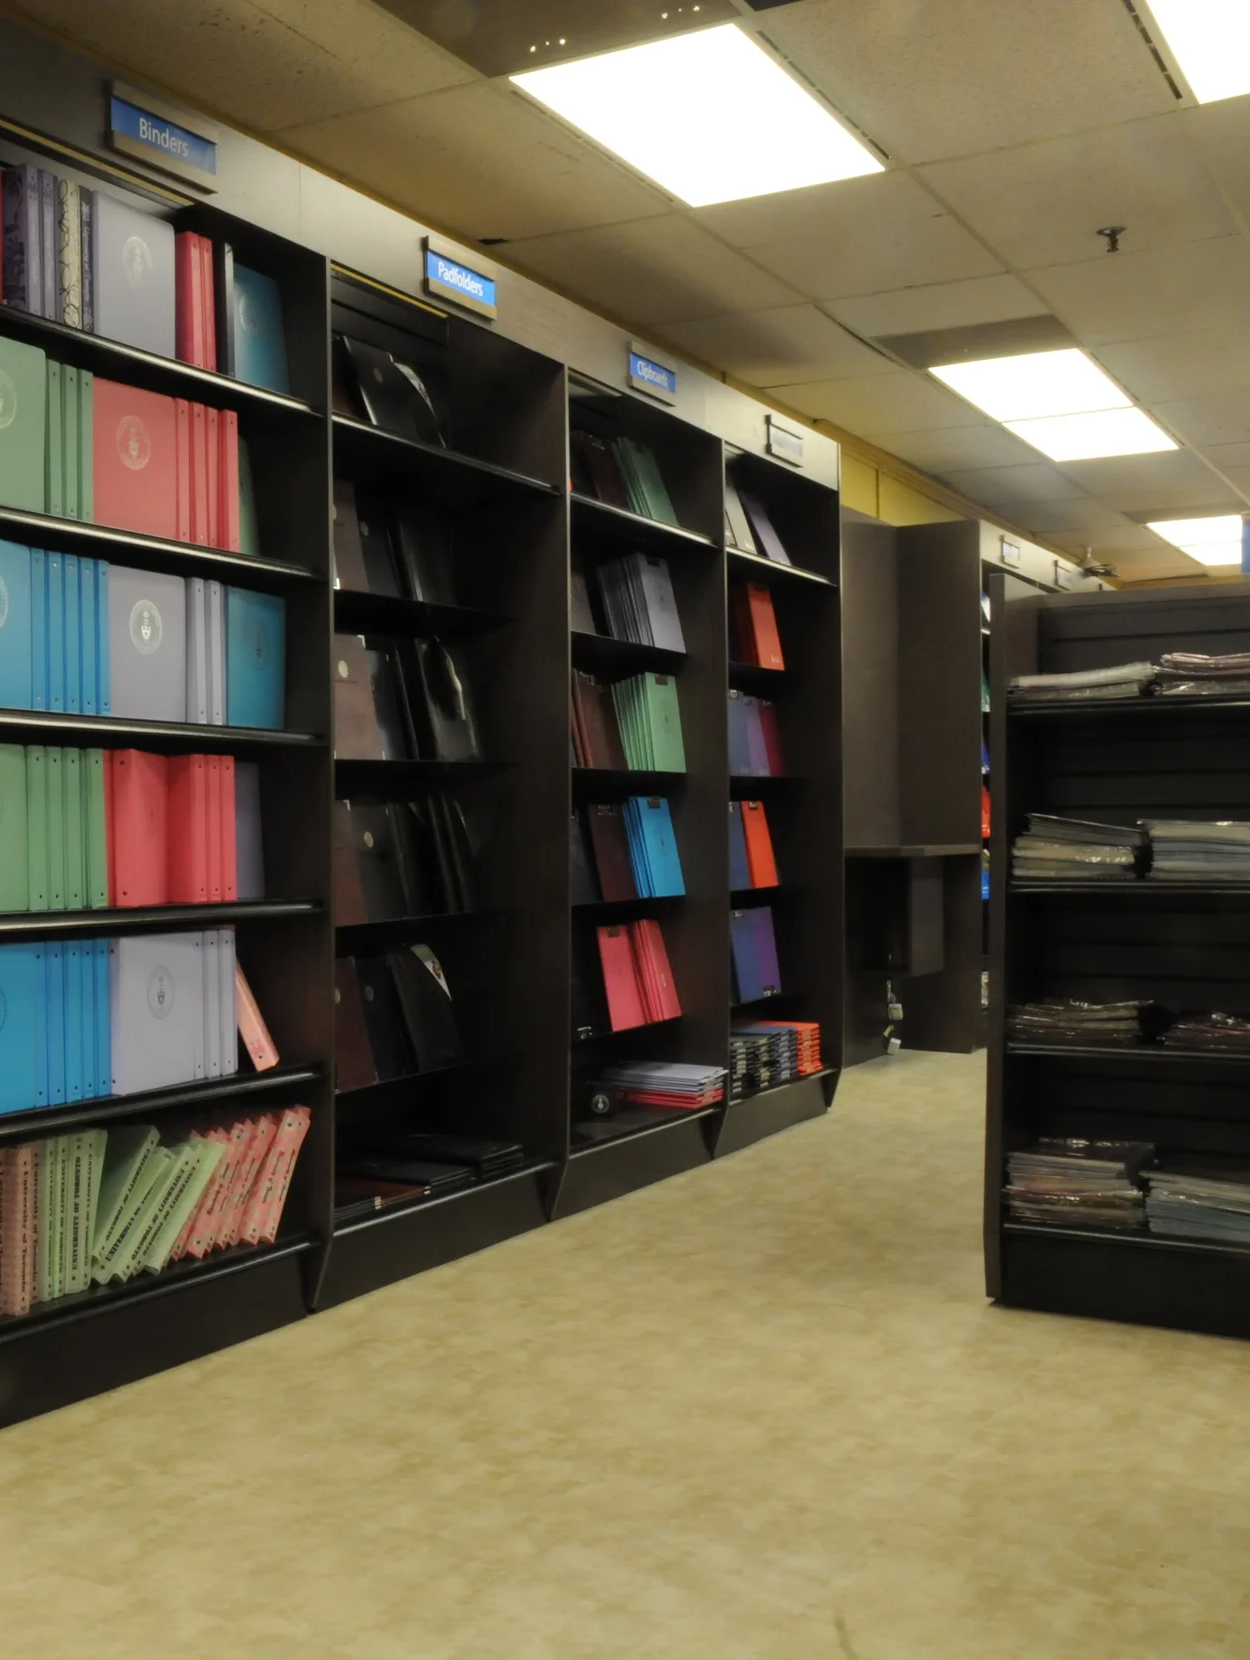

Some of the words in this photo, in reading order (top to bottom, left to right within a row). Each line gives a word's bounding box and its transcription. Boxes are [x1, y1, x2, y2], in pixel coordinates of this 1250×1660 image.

[139, 117, 188, 157] Binders
[438, 261, 483, 297] Padfolders
[21, 1170, 29, 1229] University
[74, 1157, 82, 1200] TORONTO
[158, 1168, 185, 1212] UNIVERSITY
[72, 1215, 80, 1271] UNIVERSITY
[131, 1225, 153, 1260] TORONTO
[20, 1247, 28, 1292] Toronto
